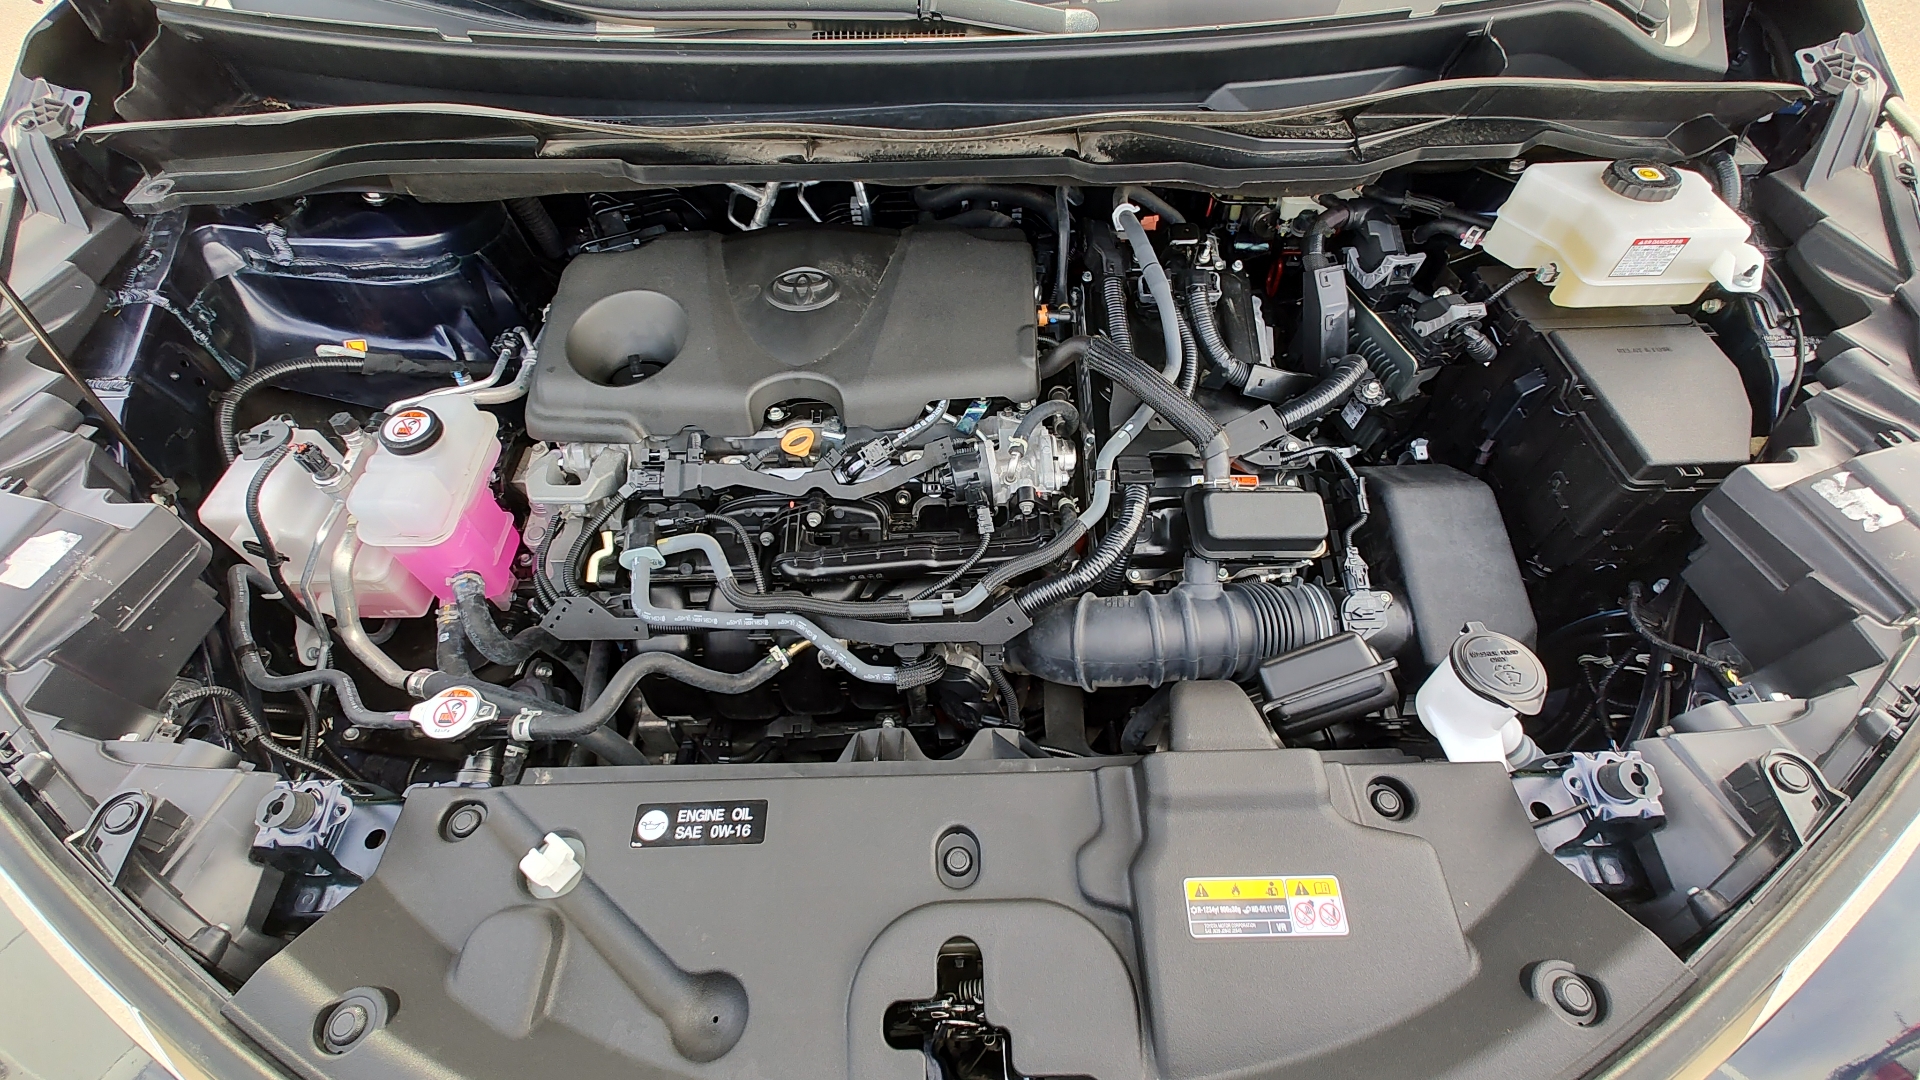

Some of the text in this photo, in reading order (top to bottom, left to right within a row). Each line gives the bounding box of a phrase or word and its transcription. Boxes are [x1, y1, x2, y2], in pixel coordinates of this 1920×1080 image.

[1469, 650, 1498, 658] WASHER
[676, 807, 753, 823] ENGINE OIL
[674, 823, 752, 840] SAE 0W-16
[1275, 923, 1288, 933] VR
